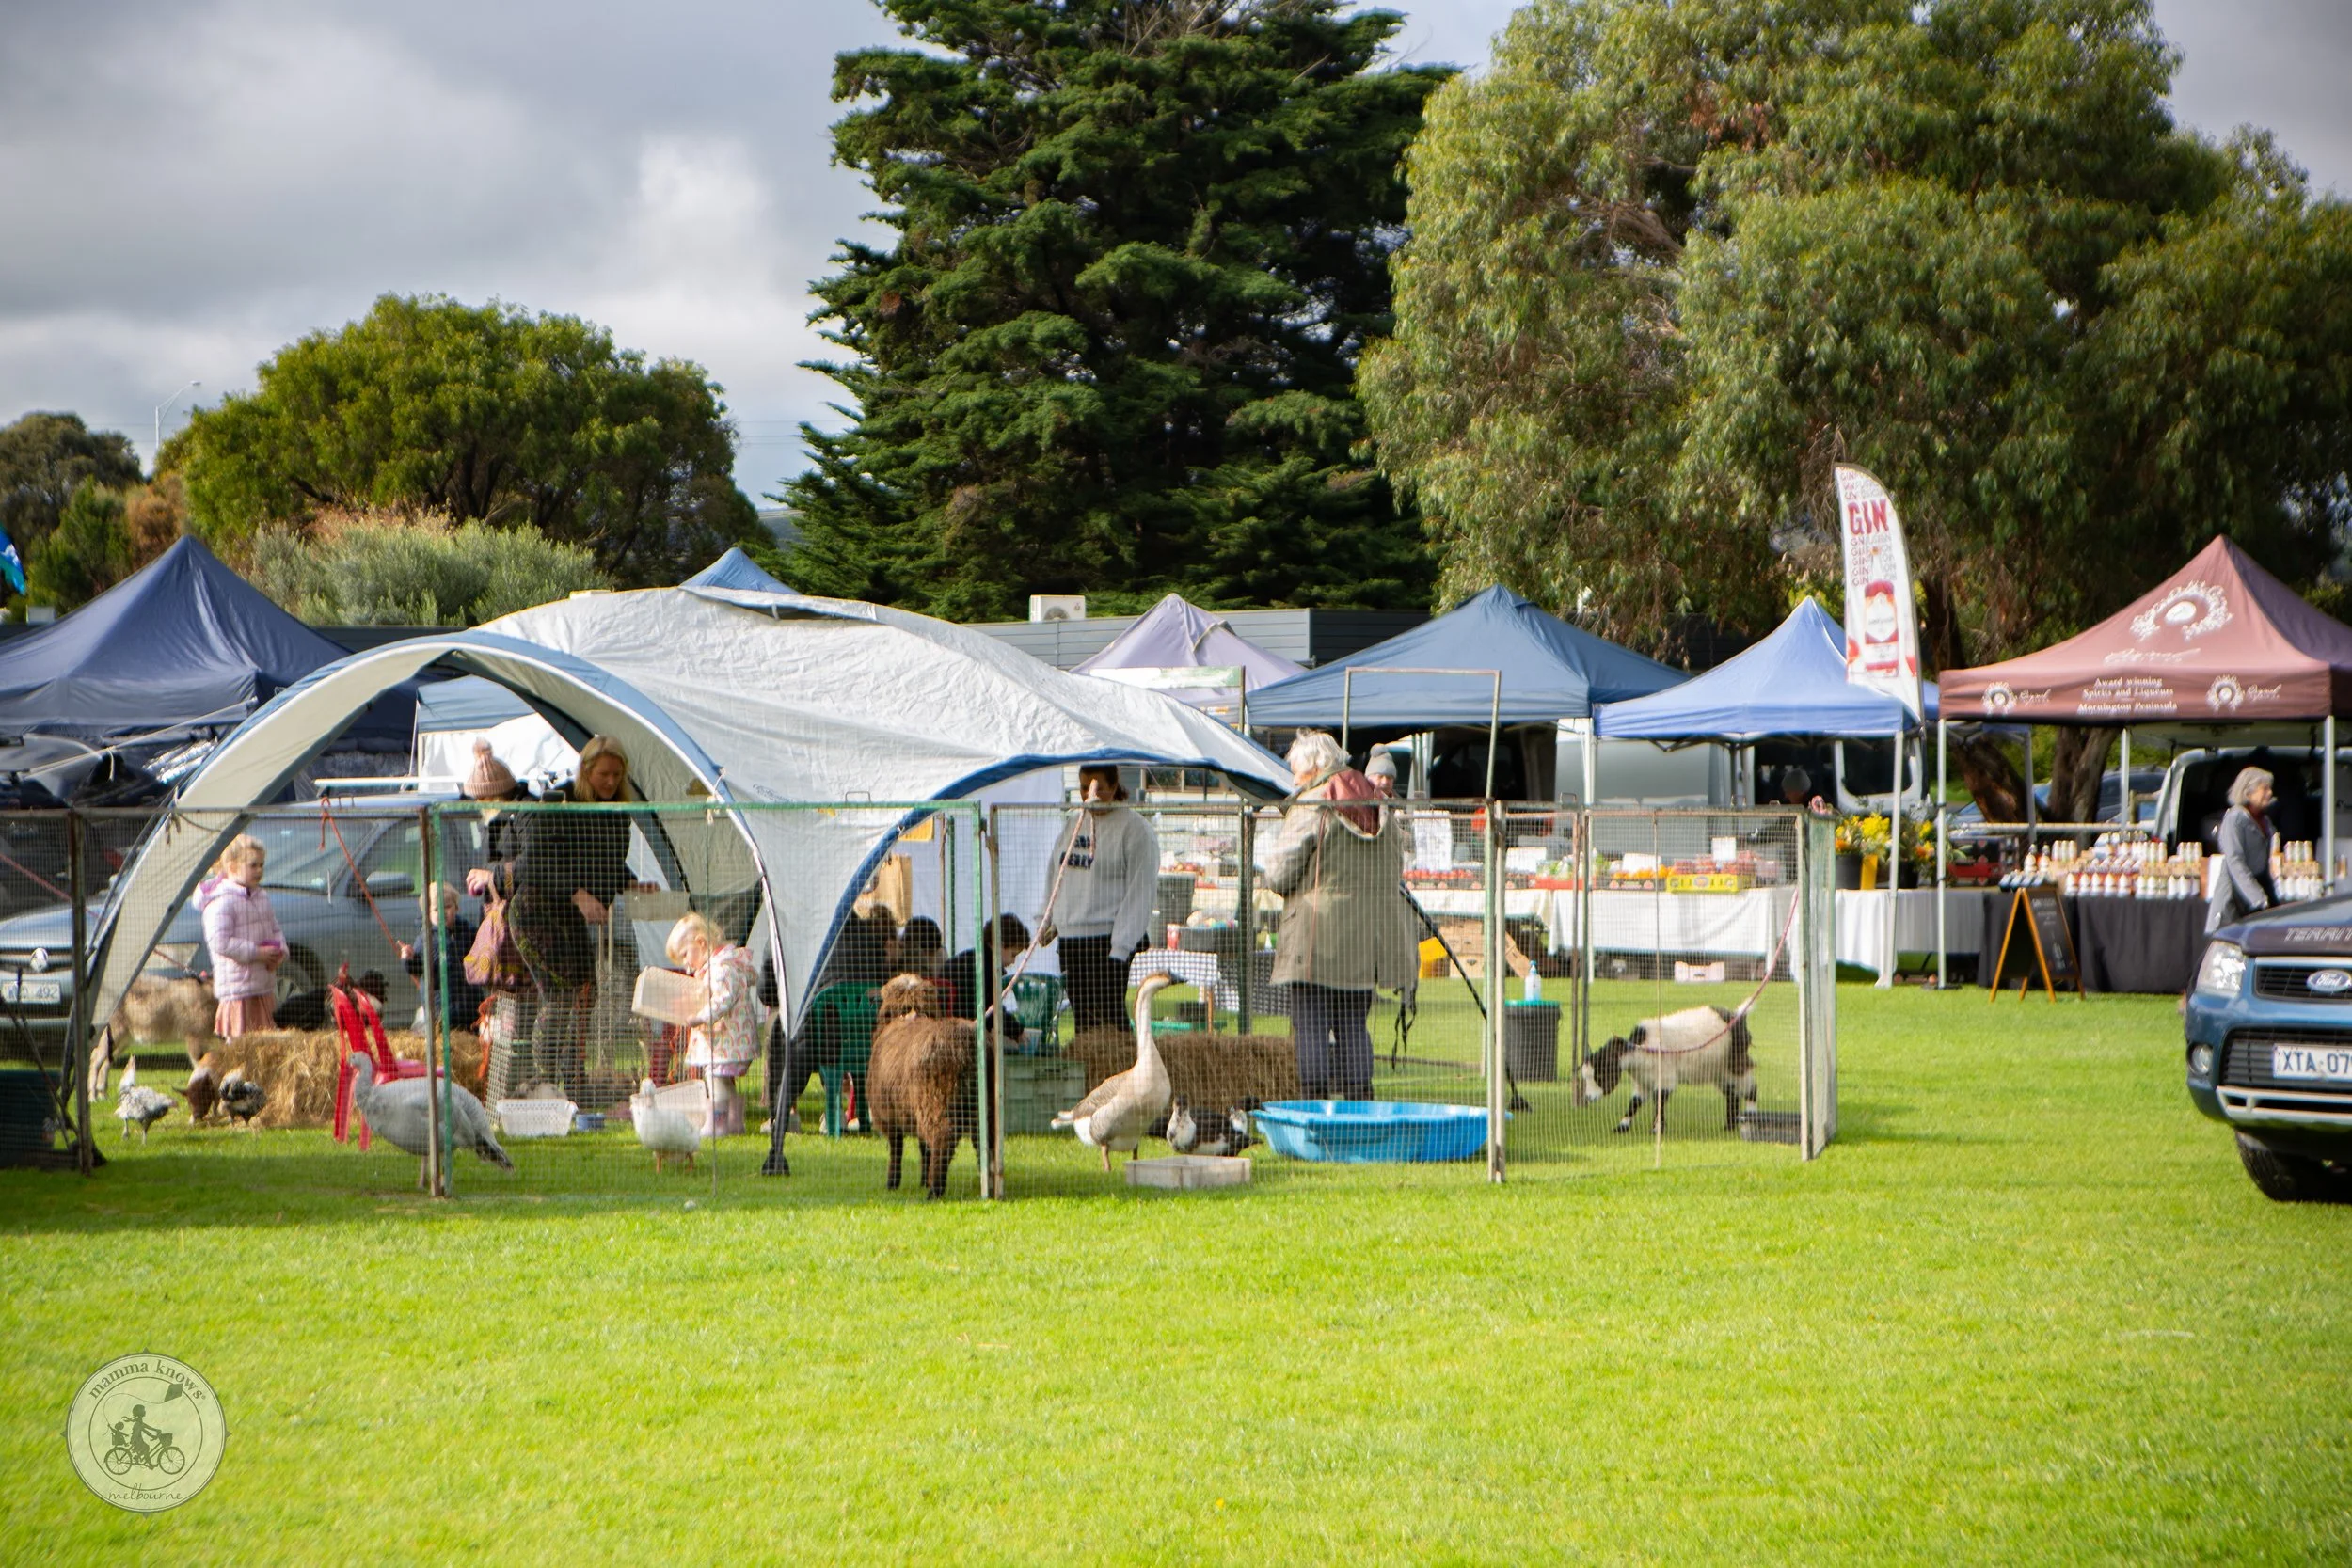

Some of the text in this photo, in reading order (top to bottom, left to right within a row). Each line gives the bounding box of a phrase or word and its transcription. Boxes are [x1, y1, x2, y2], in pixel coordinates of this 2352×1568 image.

[1847, 499, 1889, 535] GIN
[2093, 677, 2163, 689] Award winning
[2082, 687, 2174, 700] Spirits and Liqueurs
[2077, 702, 2178, 715] Mornington Peninsula
[2316, 973, 2343, 988] Ford
[2282, 1051, 2352, 1074] XTA 07
